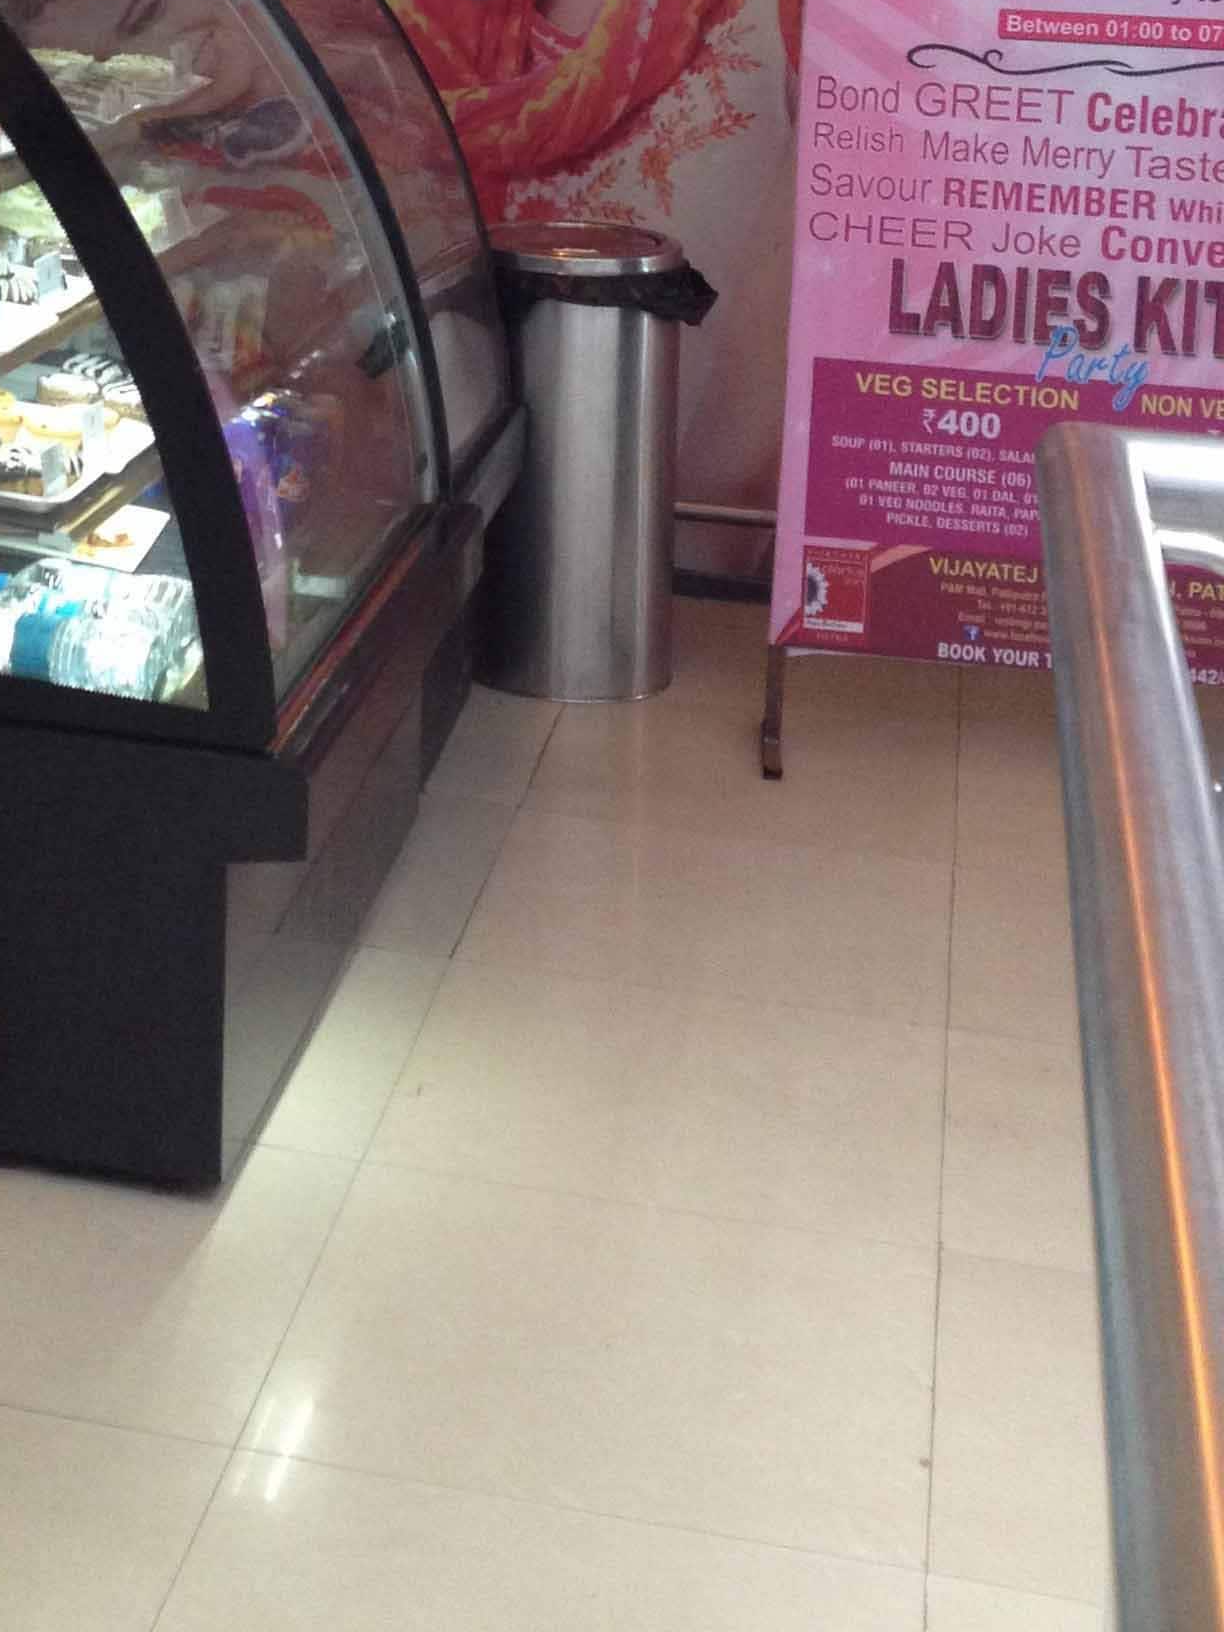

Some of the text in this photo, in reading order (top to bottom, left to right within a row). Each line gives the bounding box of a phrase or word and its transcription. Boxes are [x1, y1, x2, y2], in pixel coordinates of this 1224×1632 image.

[1006, 15, 1099, 37] Between
[1106, 20, 1164, 40] 01:00
[1172, 24, 1192, 41] to
[816, 75, 900, 113] Bond
[915, 82, 1074, 124] GREET
[813, 122, 904, 153] Relish
[922, 130, 1009, 165] Make
[1022, 136, 1114, 179] Merry
[809, 163, 932, 202] Savour
[943, 177, 1157, 222] REMEMBER
[808, 212, 974, 251] CHEER
[992, 223, 1081, 259] Joke
[889, 258, 1112, 352] LADIES
[1036, 324, 1150, 412] Party
[856, 372, 913, 397] VEG
[921, 378, 1079, 410] SELECTION
[1141, 394, 1193, 418] NON
[831, 435, 864, 450] SOUP
[901, 442, 963, 458] STARTERS
[889, 461, 929, 478] MAIN
[934, 466, 996, 485] COURSE
[878, 495, 902, 510] VEG
[936, 515, 1000, 535] DESSERTS
[928, 556, 1039, 584] VIJAYATEJ
[938, 642, 986, 663] BOOK
[993, 647, 1039, 669] YOUR
